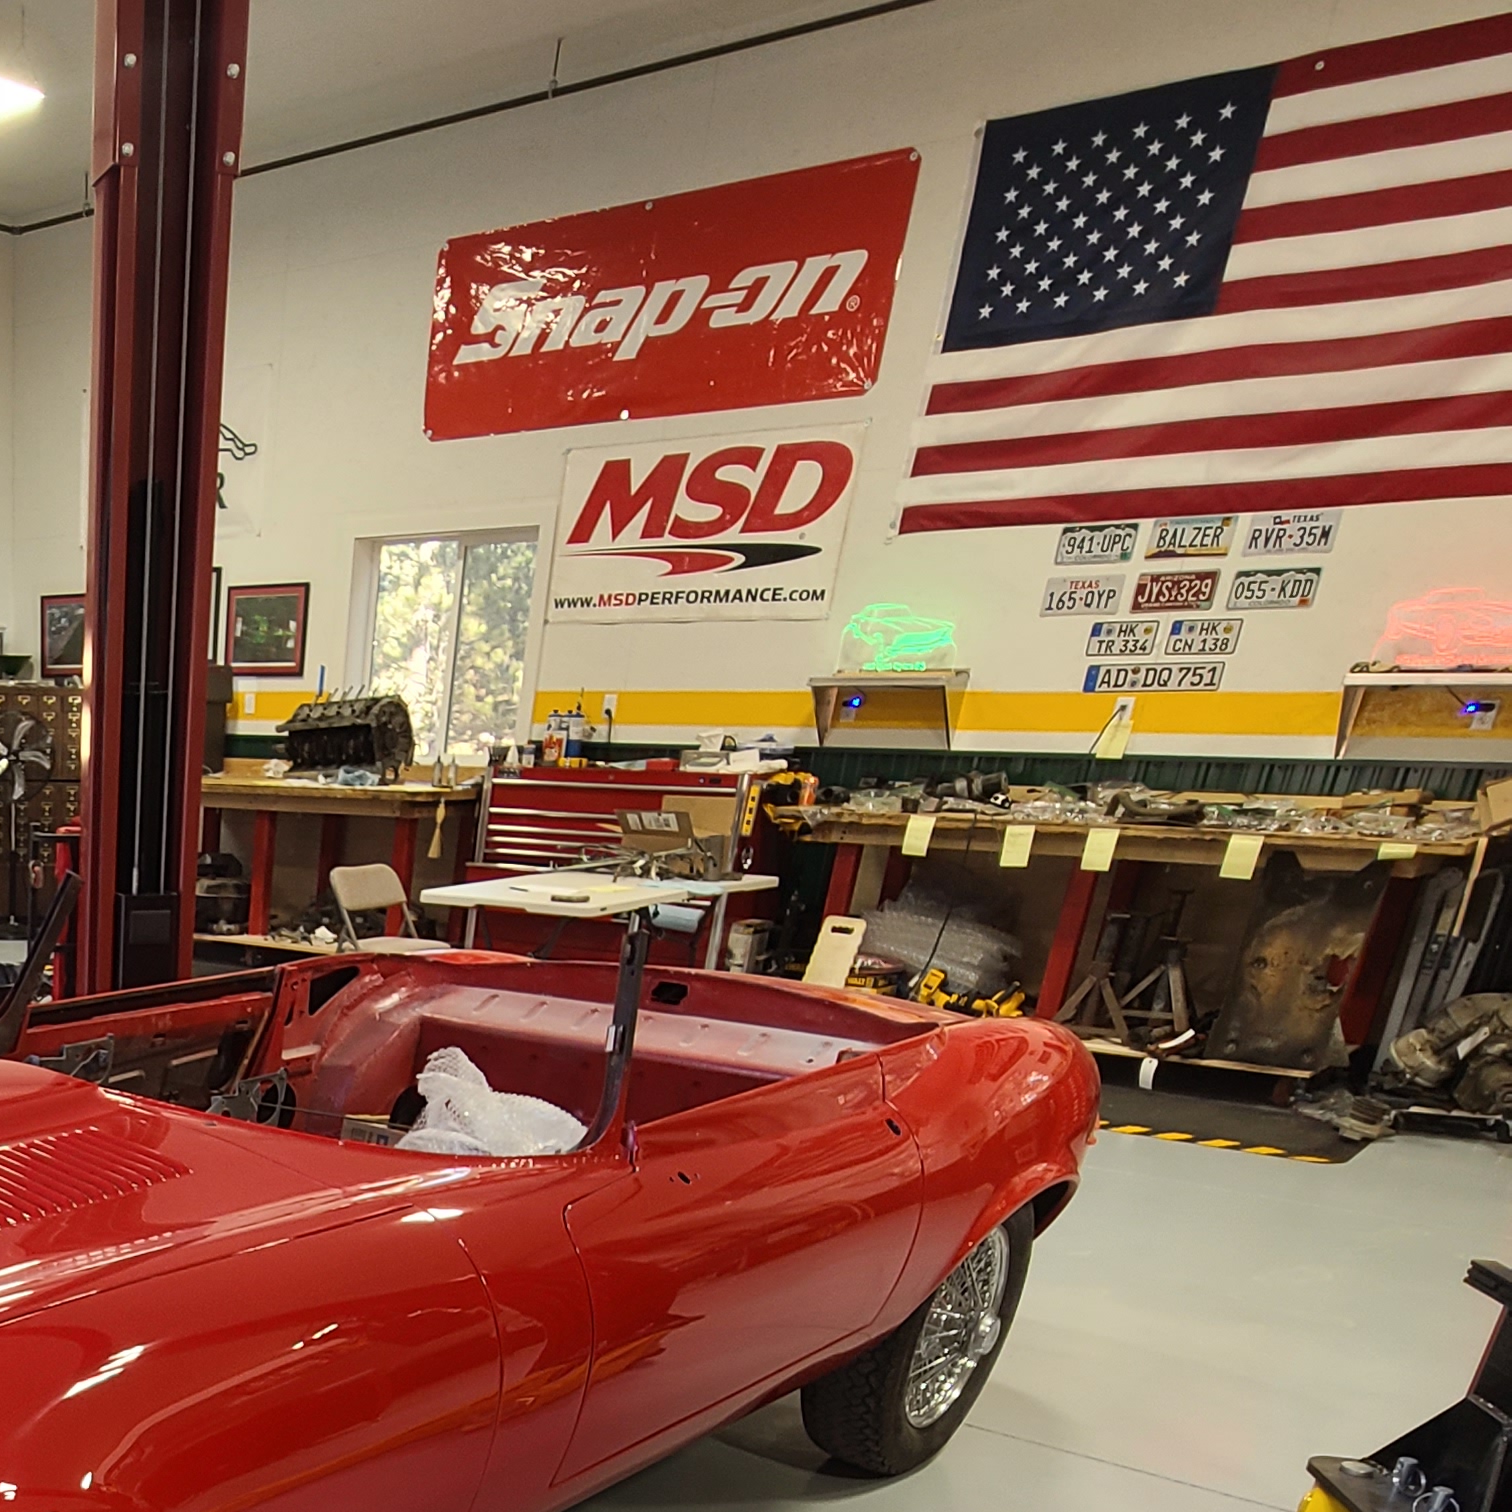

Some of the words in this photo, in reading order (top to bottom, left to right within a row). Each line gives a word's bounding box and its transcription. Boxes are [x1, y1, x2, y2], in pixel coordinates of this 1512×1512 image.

[453, 250, 869, 365] Snap-on
[566, 441, 854, 544] MSD
[1292, 513, 1320, 524] TEXAS
[1156, 526, 1224, 549] BALZER
[1069, 579, 1100, 591] TEXAS
[554, 586, 826, 610] WWW.MSDPERFORMANCE.COM
[1117, 624, 1138, 637] HK
[1198, 622, 1220, 636] HK
[1096, 640, 1115, 654] TR
[1119, 639, 1148, 654] 334
[1172, 638, 1195, 653] CN
[1199, 637, 1230, 652] 138
[1098, 668, 1129, 689] AD
[1141, 667, 1172, 688] DQ
[1178, 666, 1218, 687] 751
